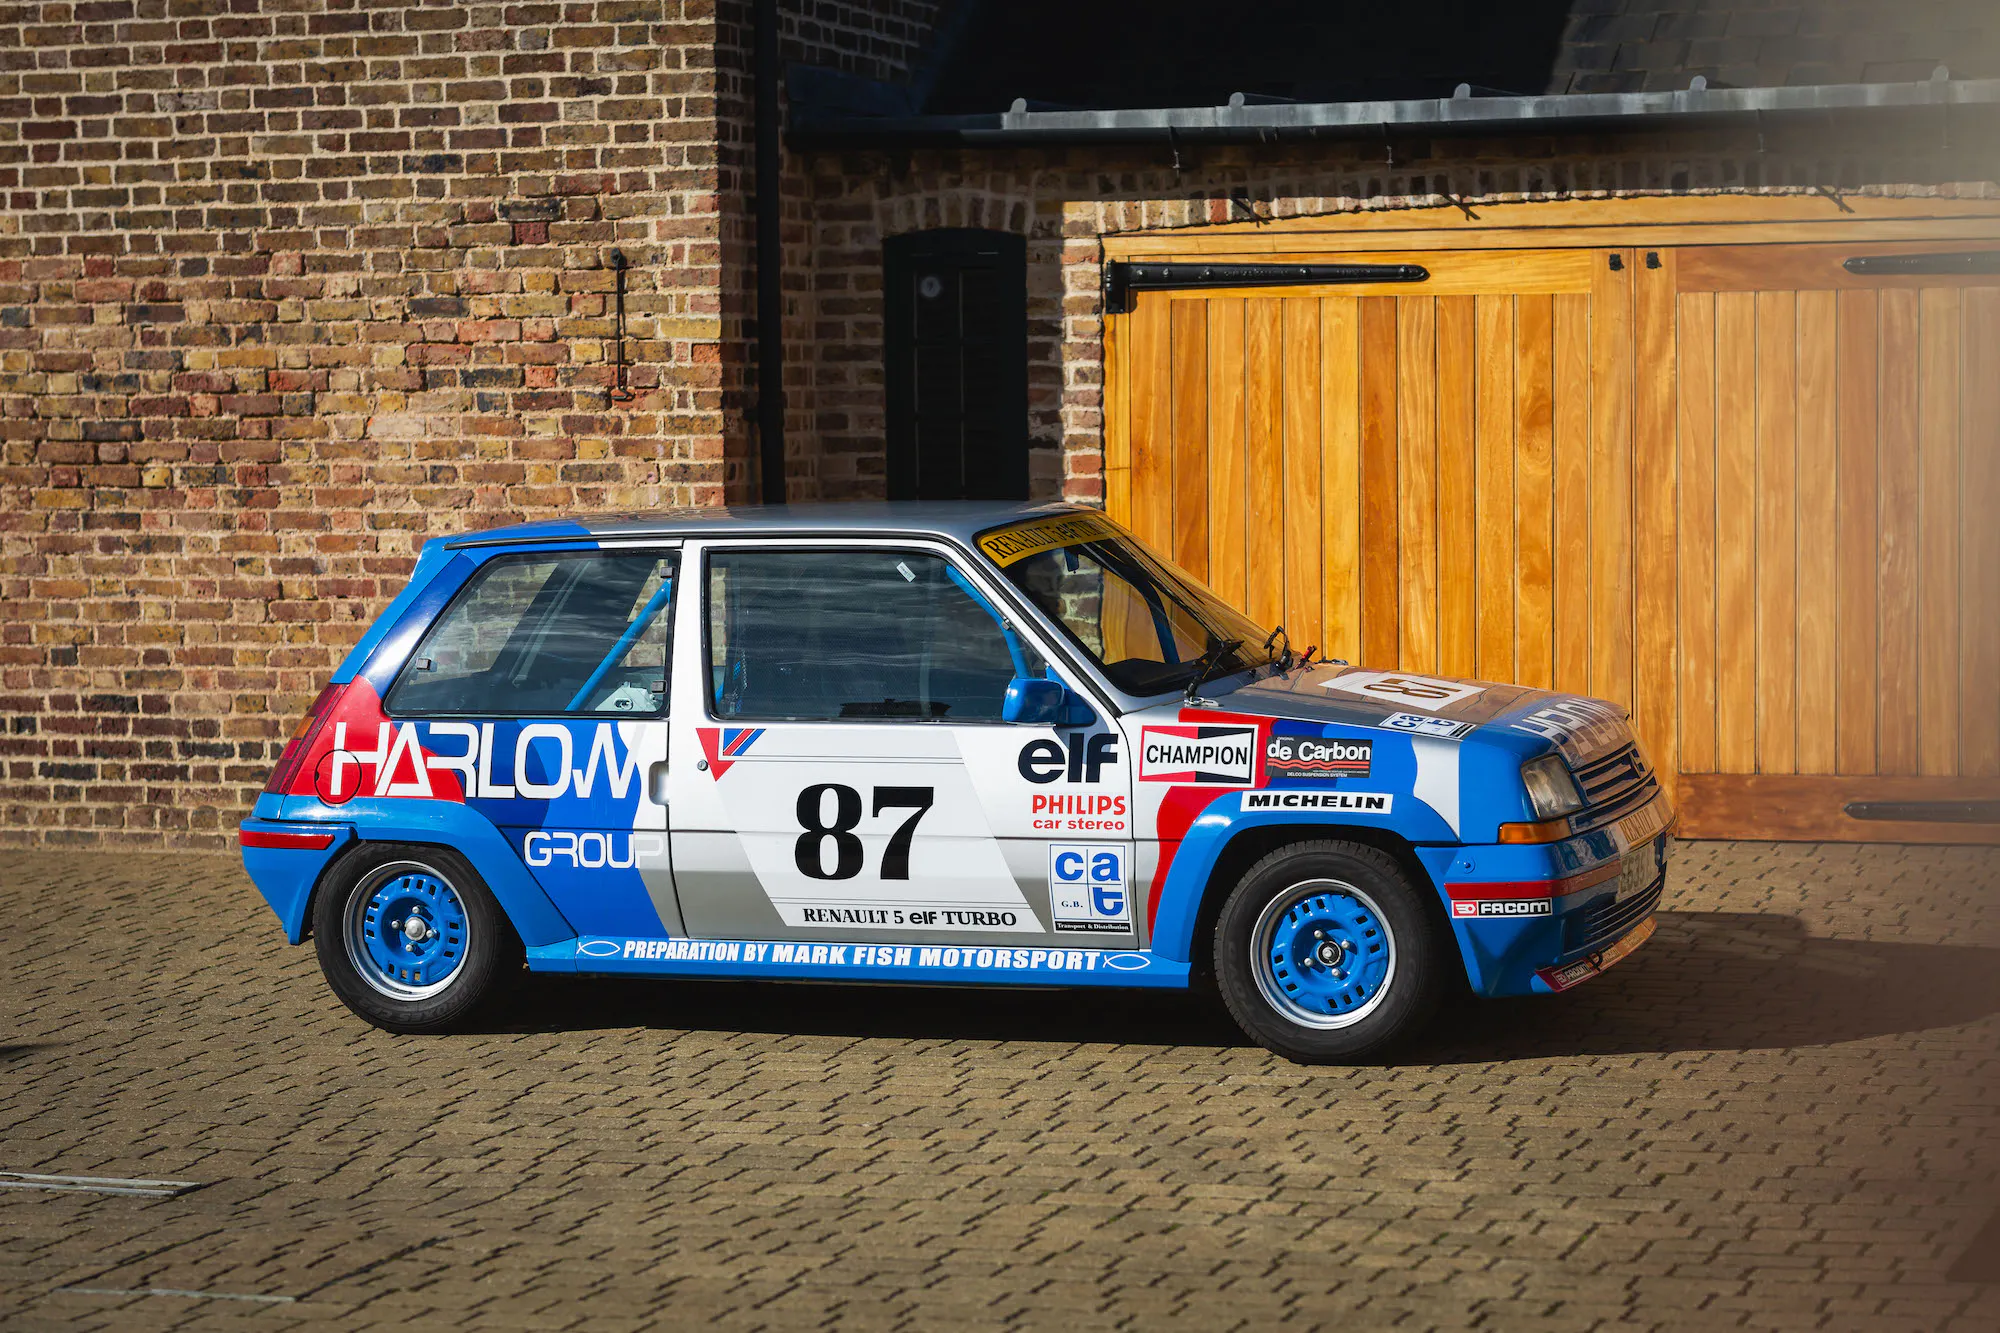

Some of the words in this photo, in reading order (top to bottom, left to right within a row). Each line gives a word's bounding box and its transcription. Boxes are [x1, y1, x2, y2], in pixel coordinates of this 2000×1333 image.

[983, 526, 1059, 559] RENAULT
[330, 721, 647, 799] HARLOW
[1017, 733, 1119, 784] elf
[1146, 744, 1248, 766] CHAMPION
[1266, 740, 1293, 760] de
[1298, 741, 1371, 762] Carbon
[1032, 794, 1126, 816] PHILIPS
[1248, 794, 1385, 810] MICHELIN
[794, 783, 935, 881] 87
[1032, 819, 1062, 830] car
[1067, 818, 1126, 831] stereo
[1618, 806, 1658, 845] RENAULT
[523, 831, 665, 869] GROUP
[1061, 900, 1084, 908] G.B.
[1480, 901, 1549, 914] FACOM
[803, 908, 889, 924] RENAULT
[894, 910, 904, 924] 5
[909, 910, 938, 925] elf
[941, 910, 1017, 926] TURBO
[1057, 922, 1086, 930] Transport
[1094, 923, 1130, 931] Distribution
[622, 940, 738, 962] PREPARATION
[743, 941, 766, 962] BY
[771, 944, 848, 965] MARK
[853, 946, 912, 967] FISH
[918, 947, 1101, 971] MOTORSPORT
